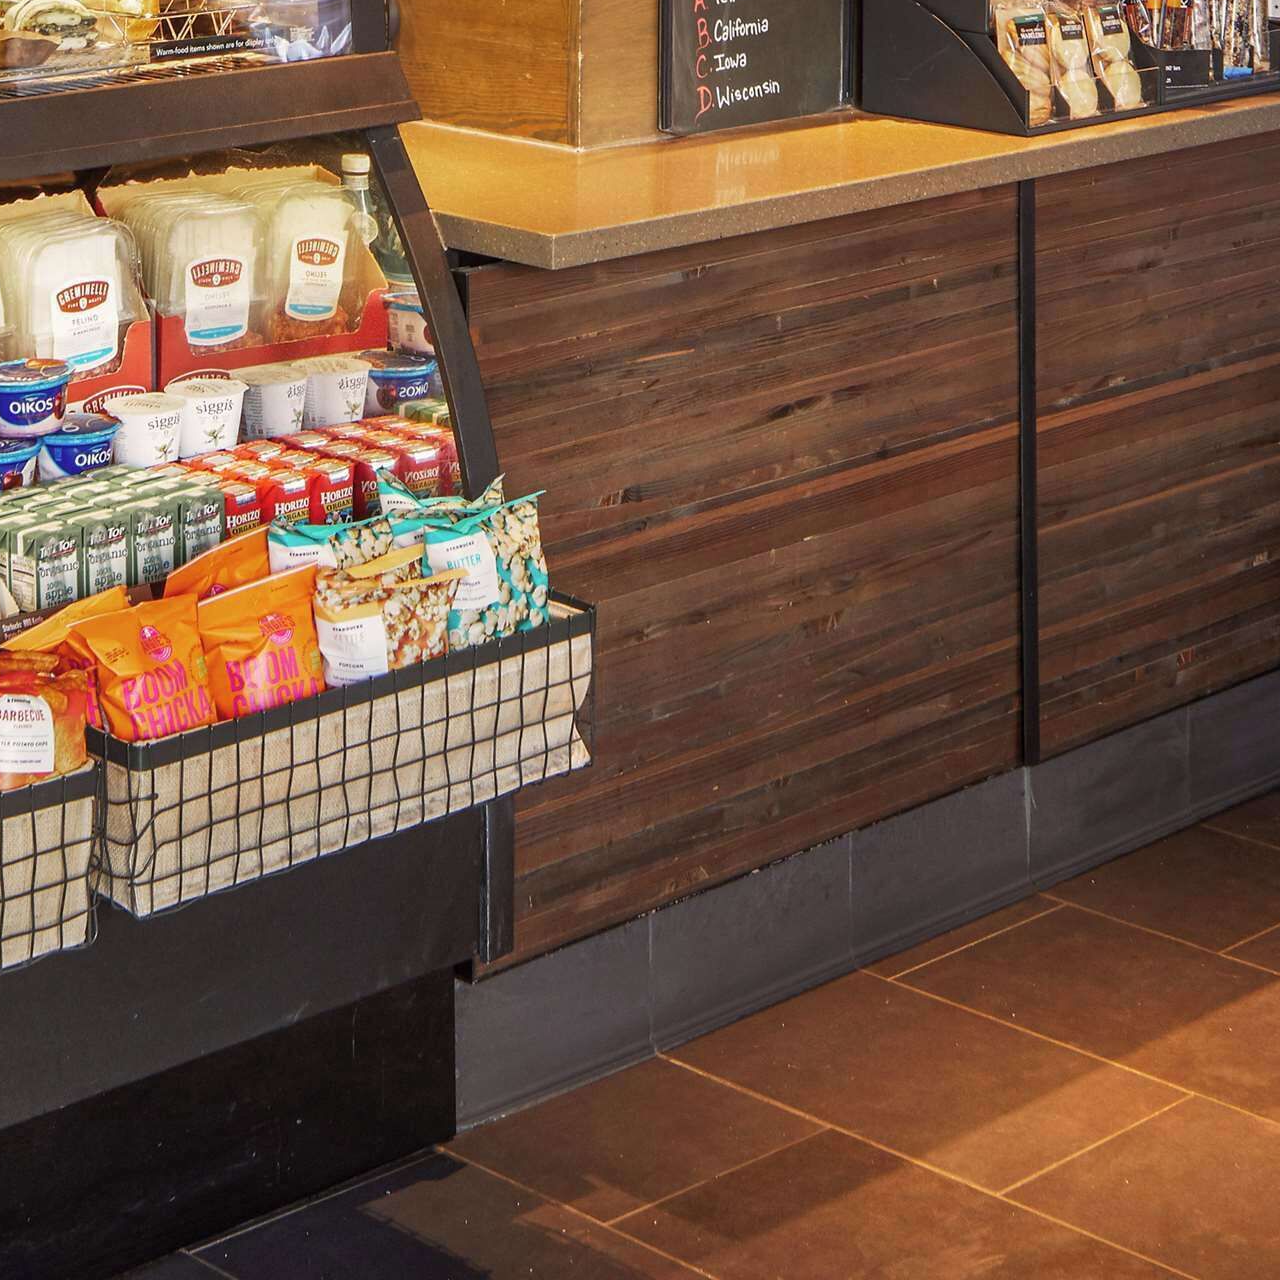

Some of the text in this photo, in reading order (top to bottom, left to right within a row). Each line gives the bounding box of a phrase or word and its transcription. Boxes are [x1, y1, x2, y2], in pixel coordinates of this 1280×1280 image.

[714, 17, 770, 42] California
[713, 52, 747, 71] Iowa
[717, 79, 780, 109] Wisconsin
[57, 281, 108, 305] CREMINELLI
[8, 400, 54, 415] OIKOS
[122, 660, 189, 712] BOOM
